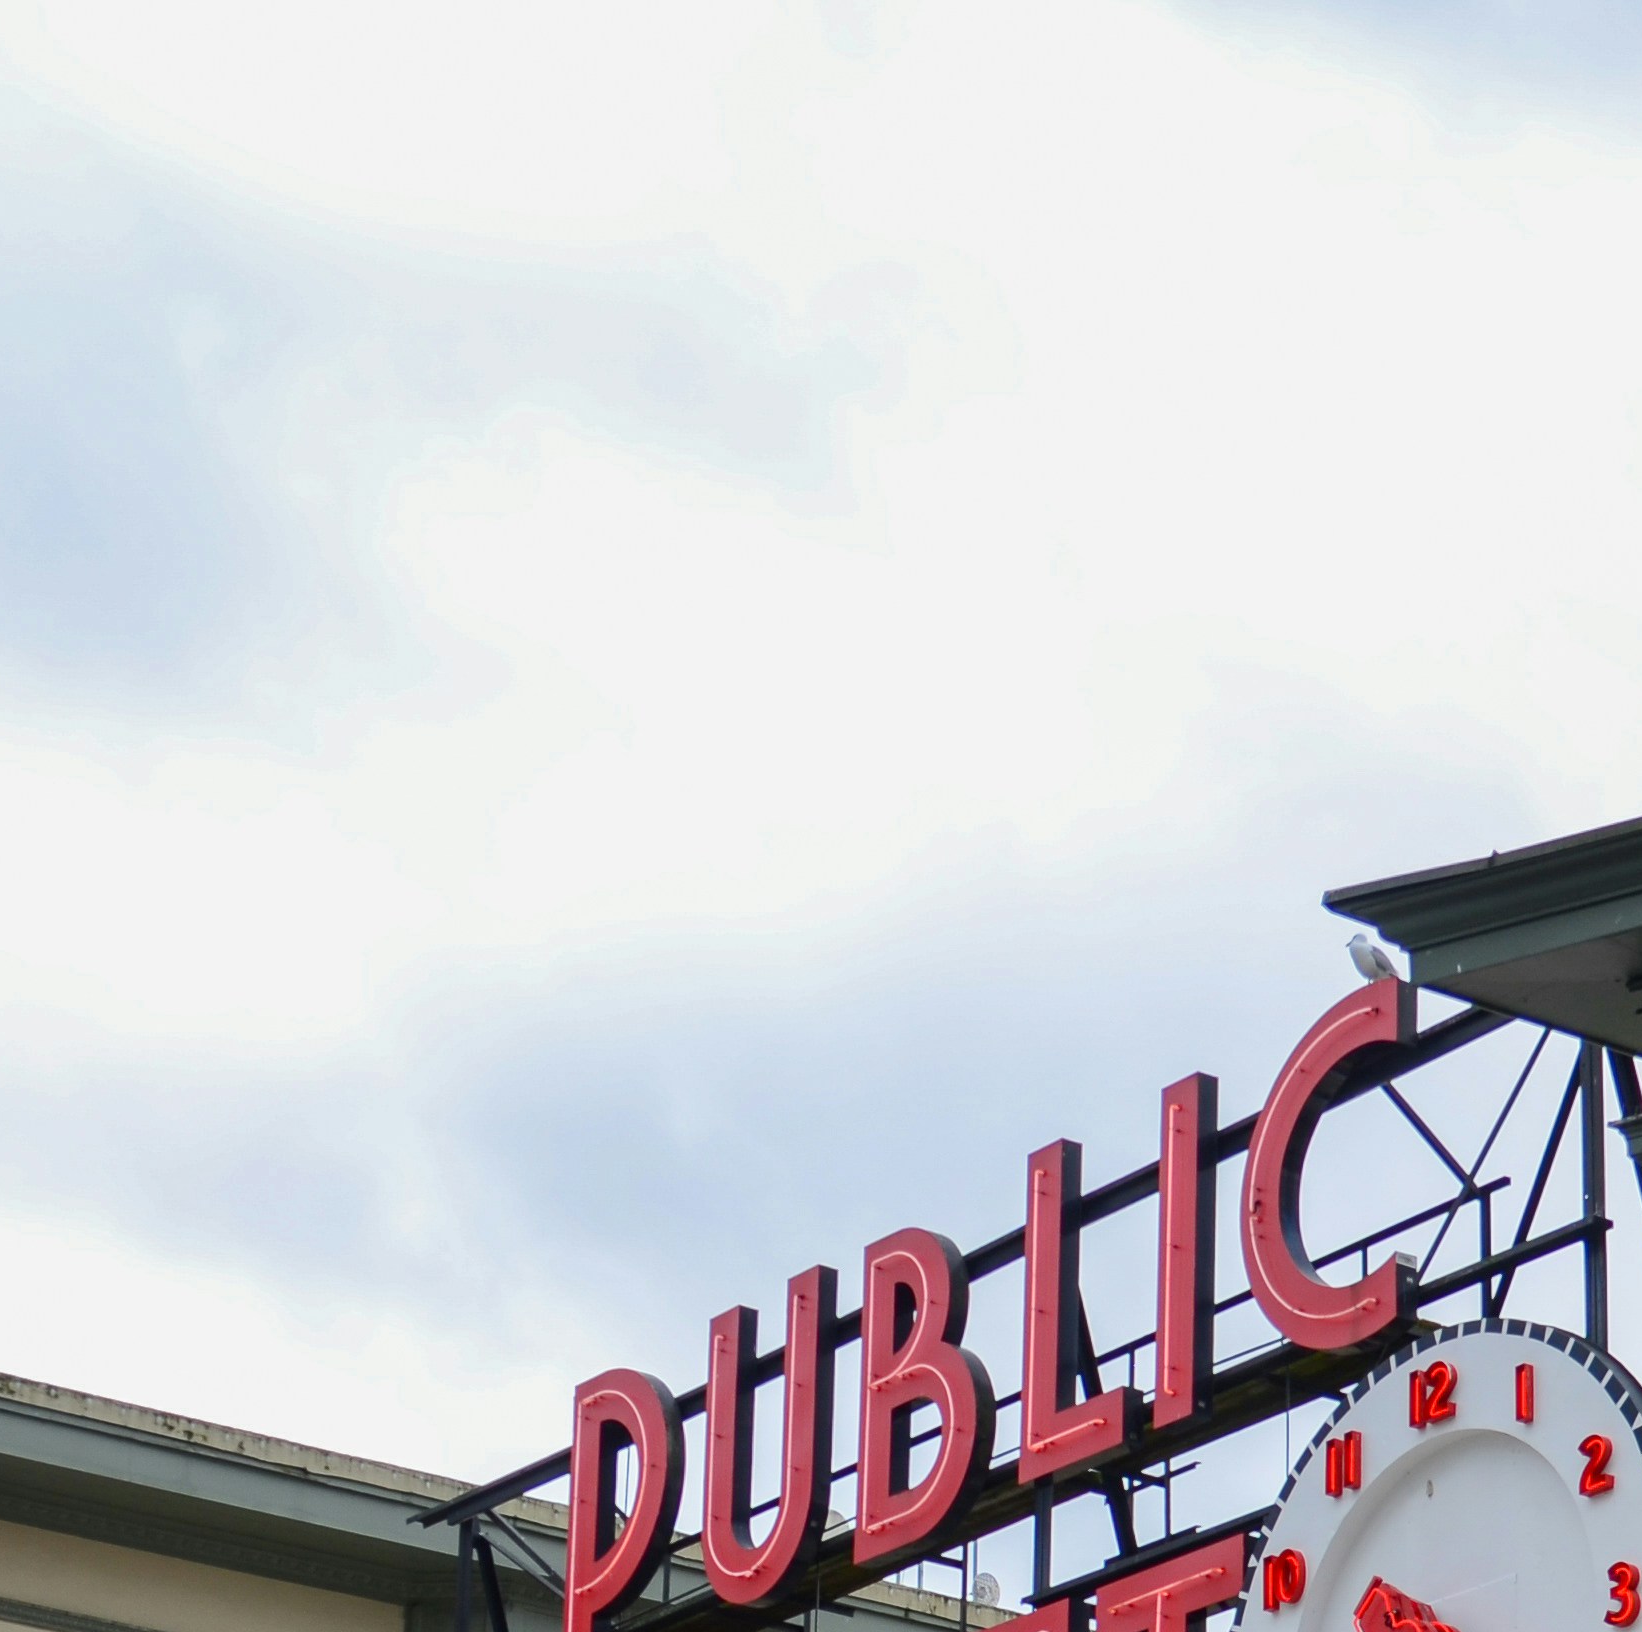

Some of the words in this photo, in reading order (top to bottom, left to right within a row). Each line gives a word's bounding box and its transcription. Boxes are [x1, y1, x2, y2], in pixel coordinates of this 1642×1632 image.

[1409, 1361, 1457, 1428] 12
[1515, 1362, 1533, 1424] 1
[1325, 1431, 1362, 1497] 11
[1578, 1435, 1615, 1498] 2
[1263, 1548, 1306, 1611] 10
[1605, 1562, 1641, 1628] 3
